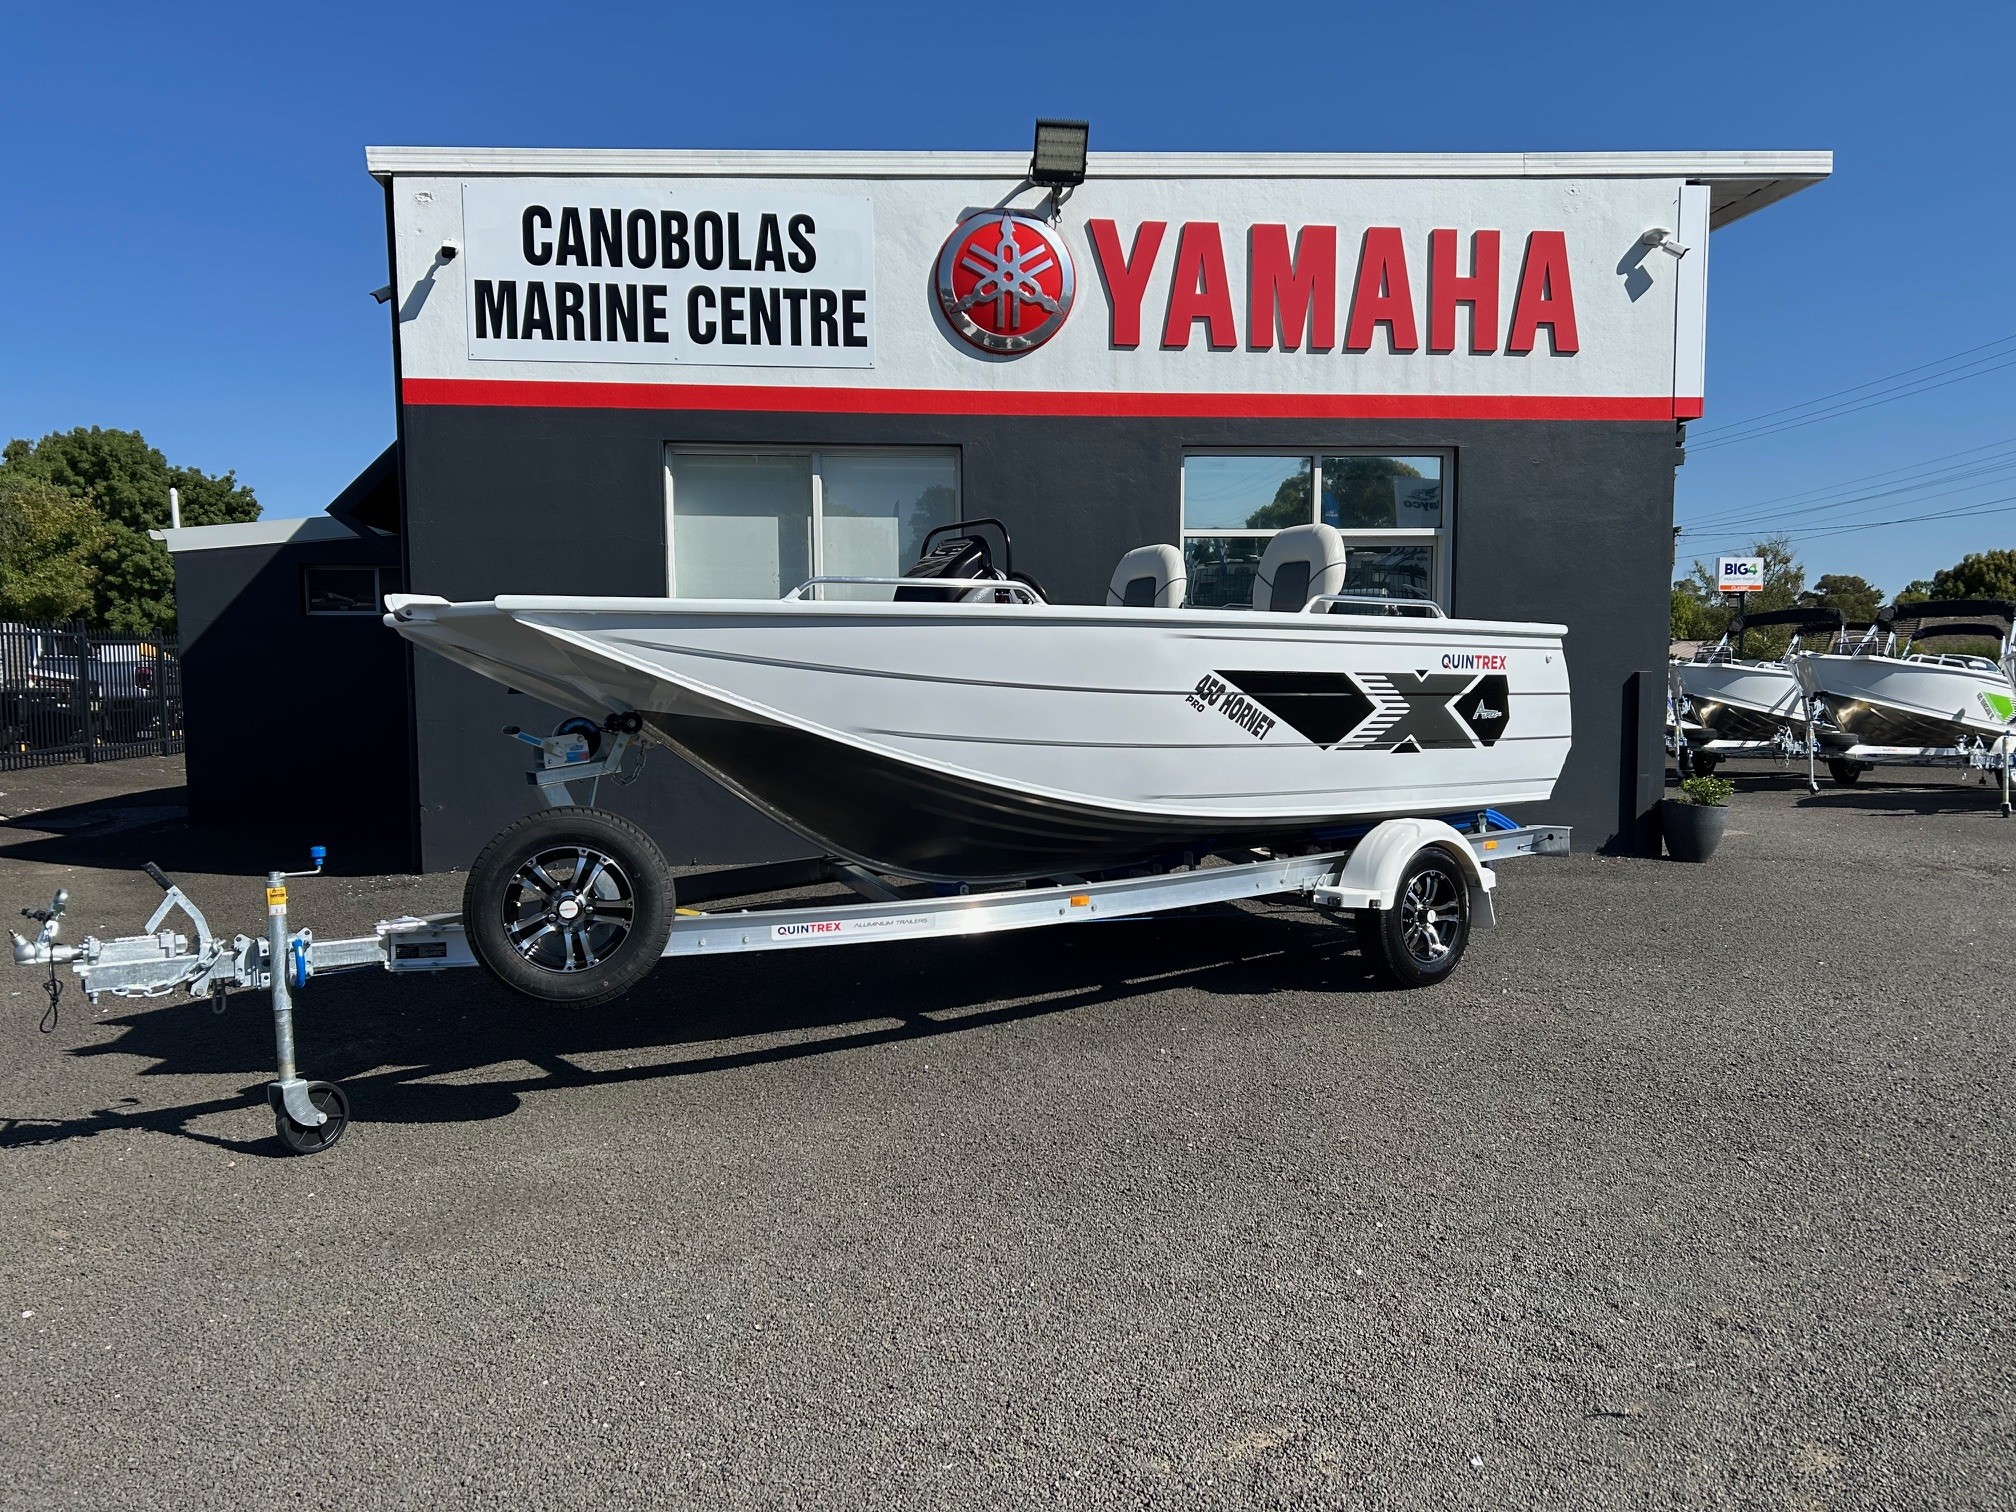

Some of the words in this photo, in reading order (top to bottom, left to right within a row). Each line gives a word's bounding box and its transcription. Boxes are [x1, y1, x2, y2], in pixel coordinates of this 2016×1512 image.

[521, 204, 817, 274] CANOBOLAS
[1087, 217, 1580, 354] YAMAHA
[474, 279, 670, 344] MARINE
[686, 284, 869, 348] CENTRE
[1725, 563, 1757, 575] BIG4
[1441, 653, 1507, 670] QUINTREX
[1185, 694, 1206, 713] PRO
[1194, 673, 1227, 706] 450
[1217, 691, 1277, 741] HORNET
[777, 922, 842, 936] QUINTREX
[853, 920, 894, 928] ALUMINIUM
[895, 917, 928, 926] TRAILERS
